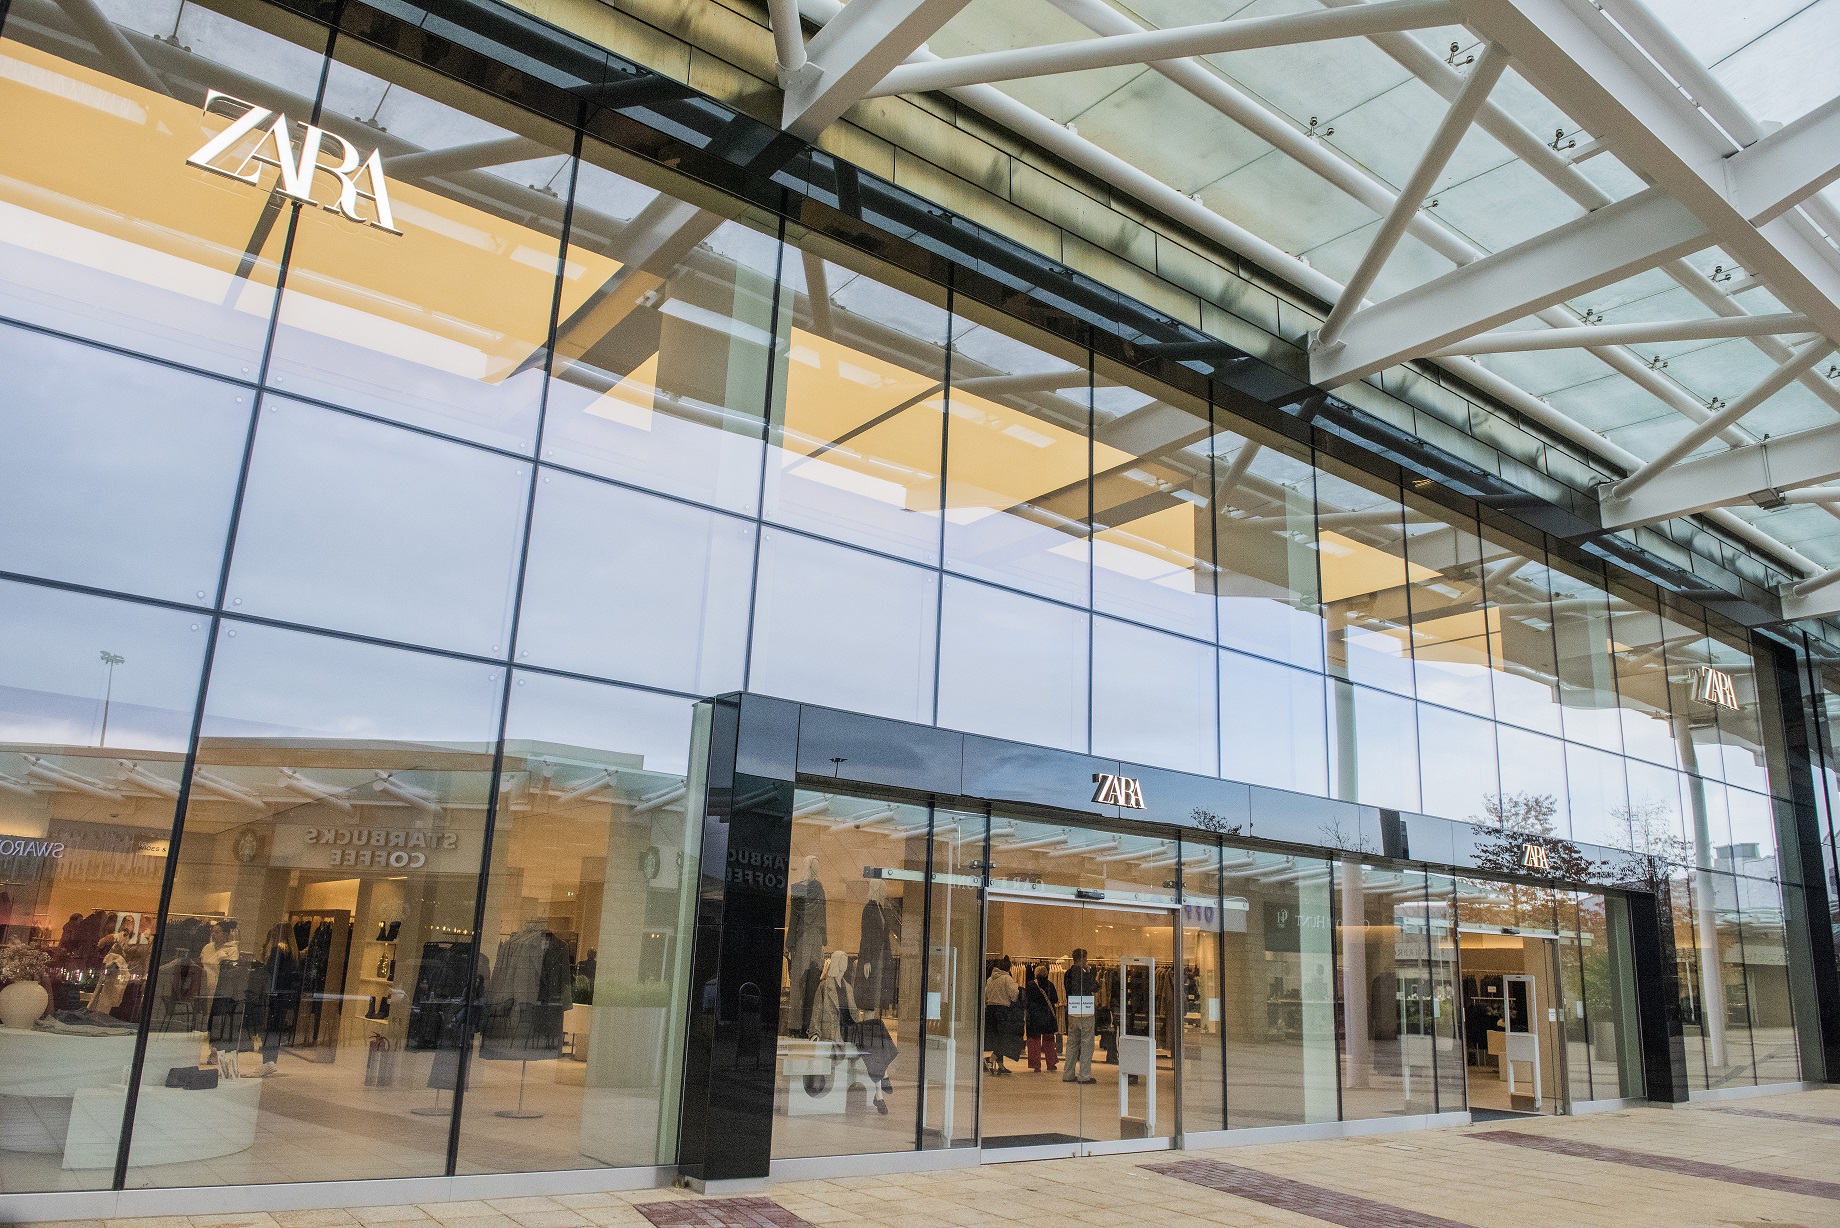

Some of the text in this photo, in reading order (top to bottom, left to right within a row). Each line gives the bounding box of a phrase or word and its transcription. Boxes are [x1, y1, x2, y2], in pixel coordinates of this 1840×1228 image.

[186, 88, 404, 237] ZARA
[1702, 666, 1740, 710] ZARA
[1091, 773, 1147, 809] ZARA
[1522, 843, 1550, 869] ZARA
